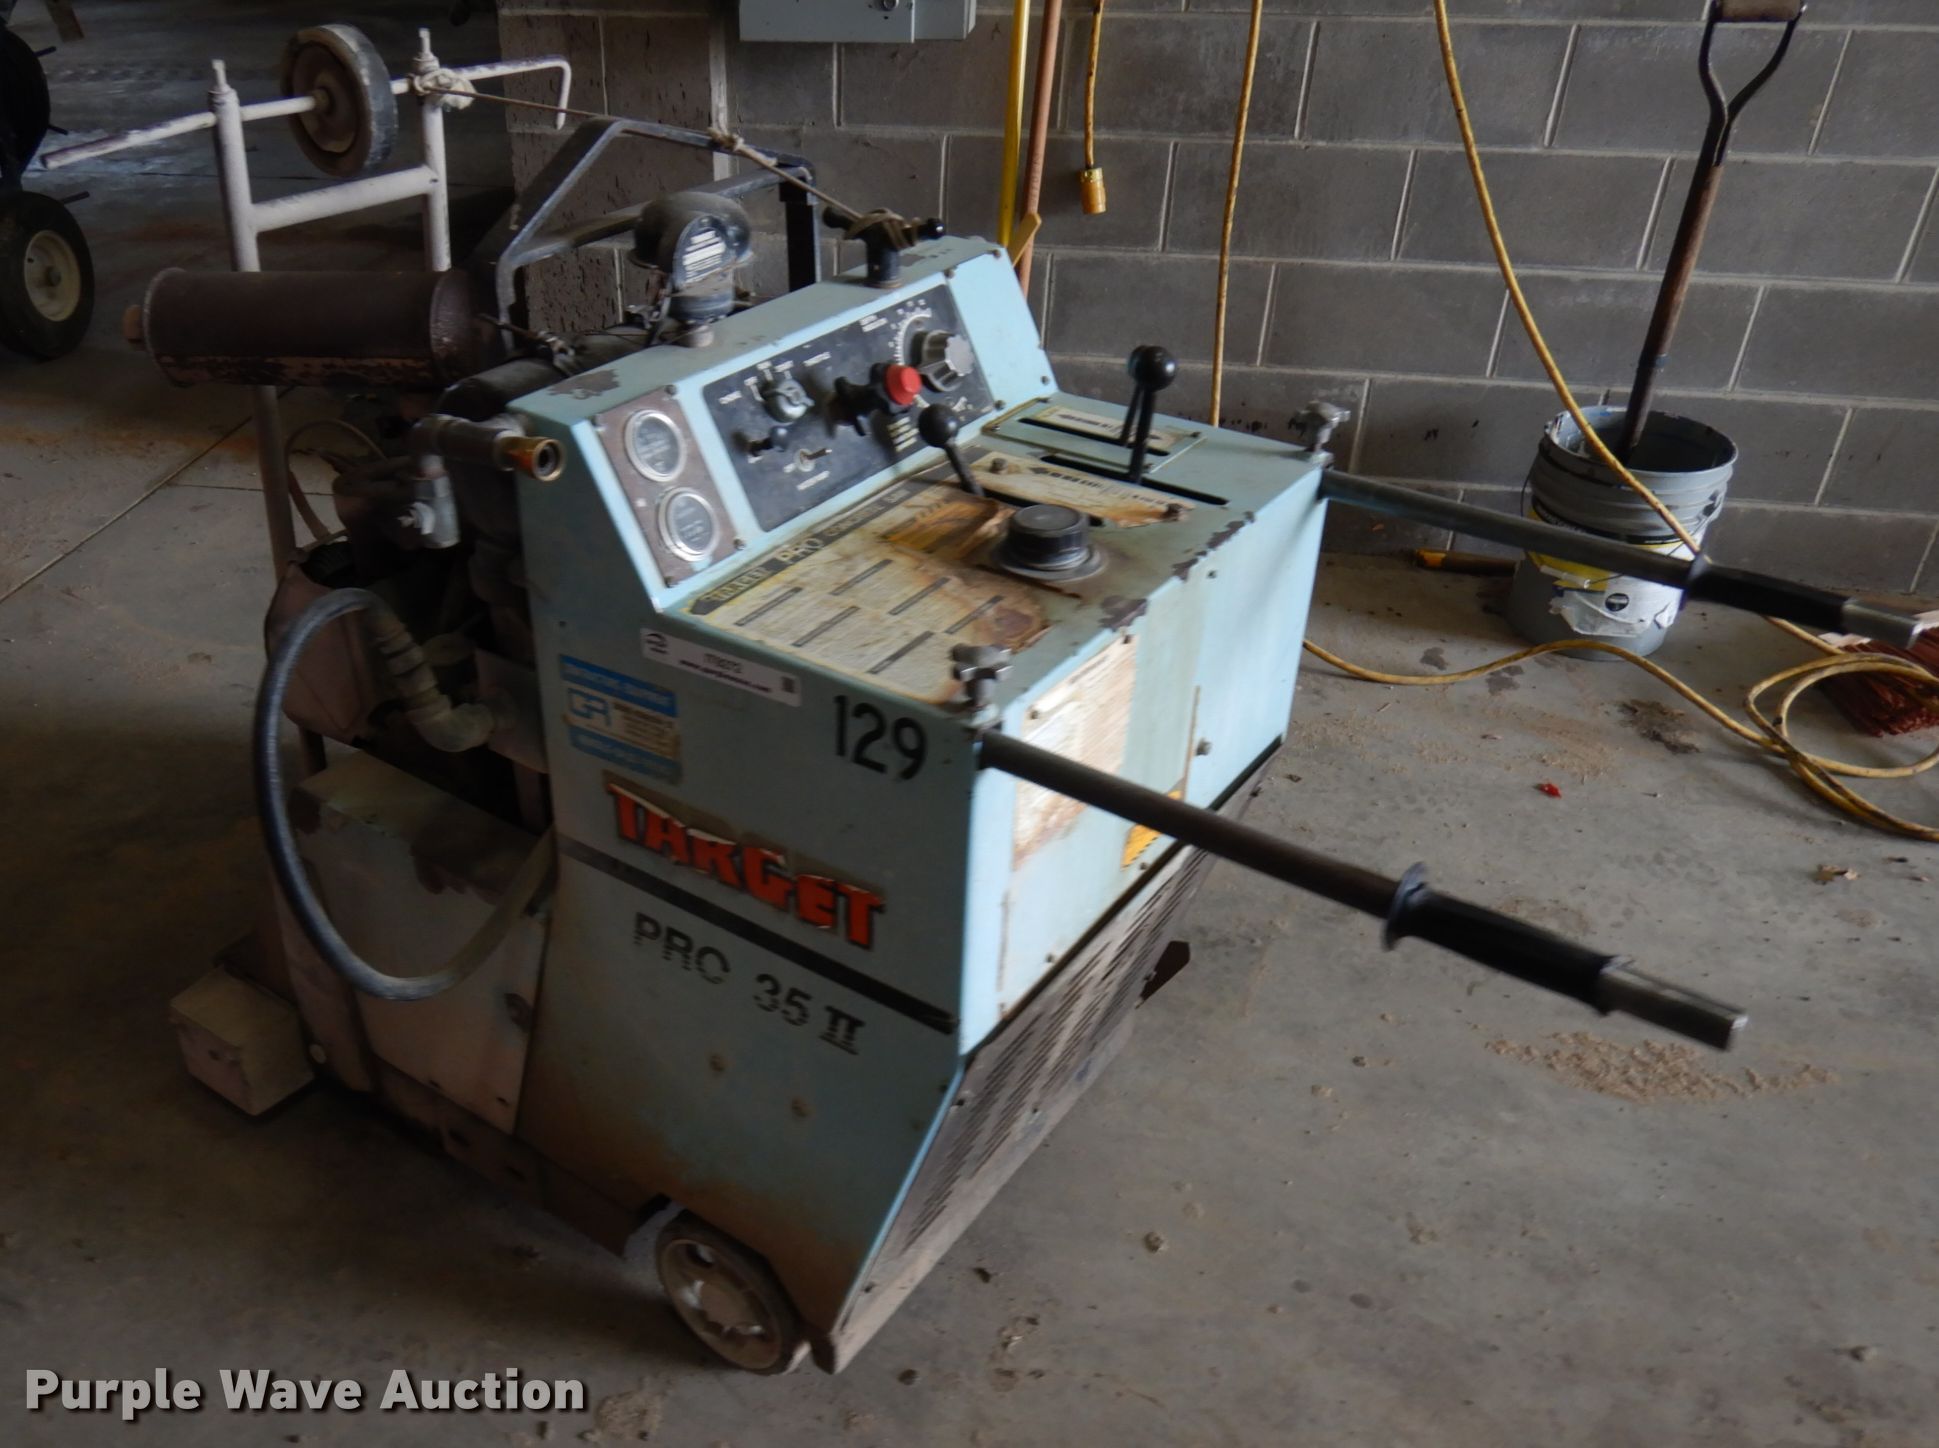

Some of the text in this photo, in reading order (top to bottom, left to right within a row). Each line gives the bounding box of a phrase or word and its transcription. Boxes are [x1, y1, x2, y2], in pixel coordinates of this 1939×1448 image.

[834, 695, 927, 780] 129
[606, 783, 887, 951] TARGET
[634, 912, 731, 985] PRO
[753, 973, 813, 1027] 35
